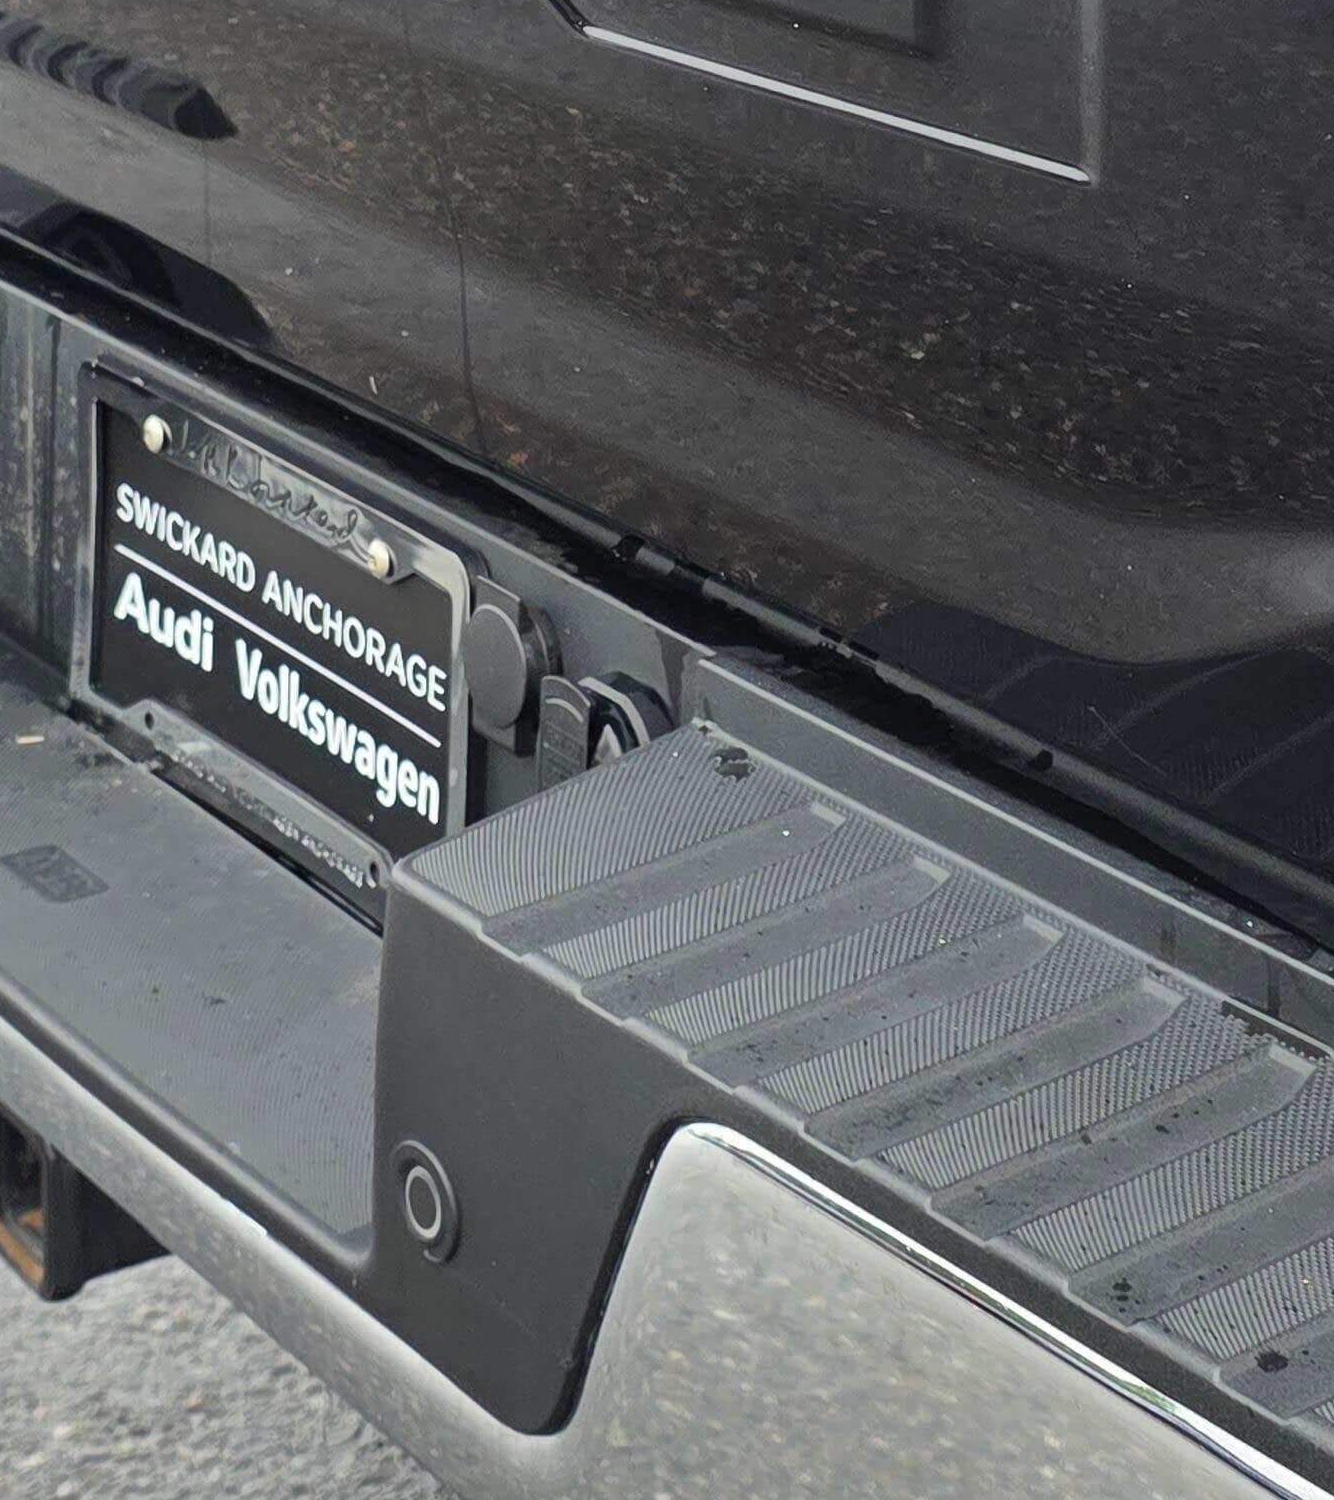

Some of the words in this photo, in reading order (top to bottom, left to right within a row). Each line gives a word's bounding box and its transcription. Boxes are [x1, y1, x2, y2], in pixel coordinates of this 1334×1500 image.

[113, 572, 214, 673] Audi
[235, 638, 440, 825] Volkswagen
[116, 482, 256, 593] SWICKARD
[261, 570, 448, 712] ANCHORAGE
